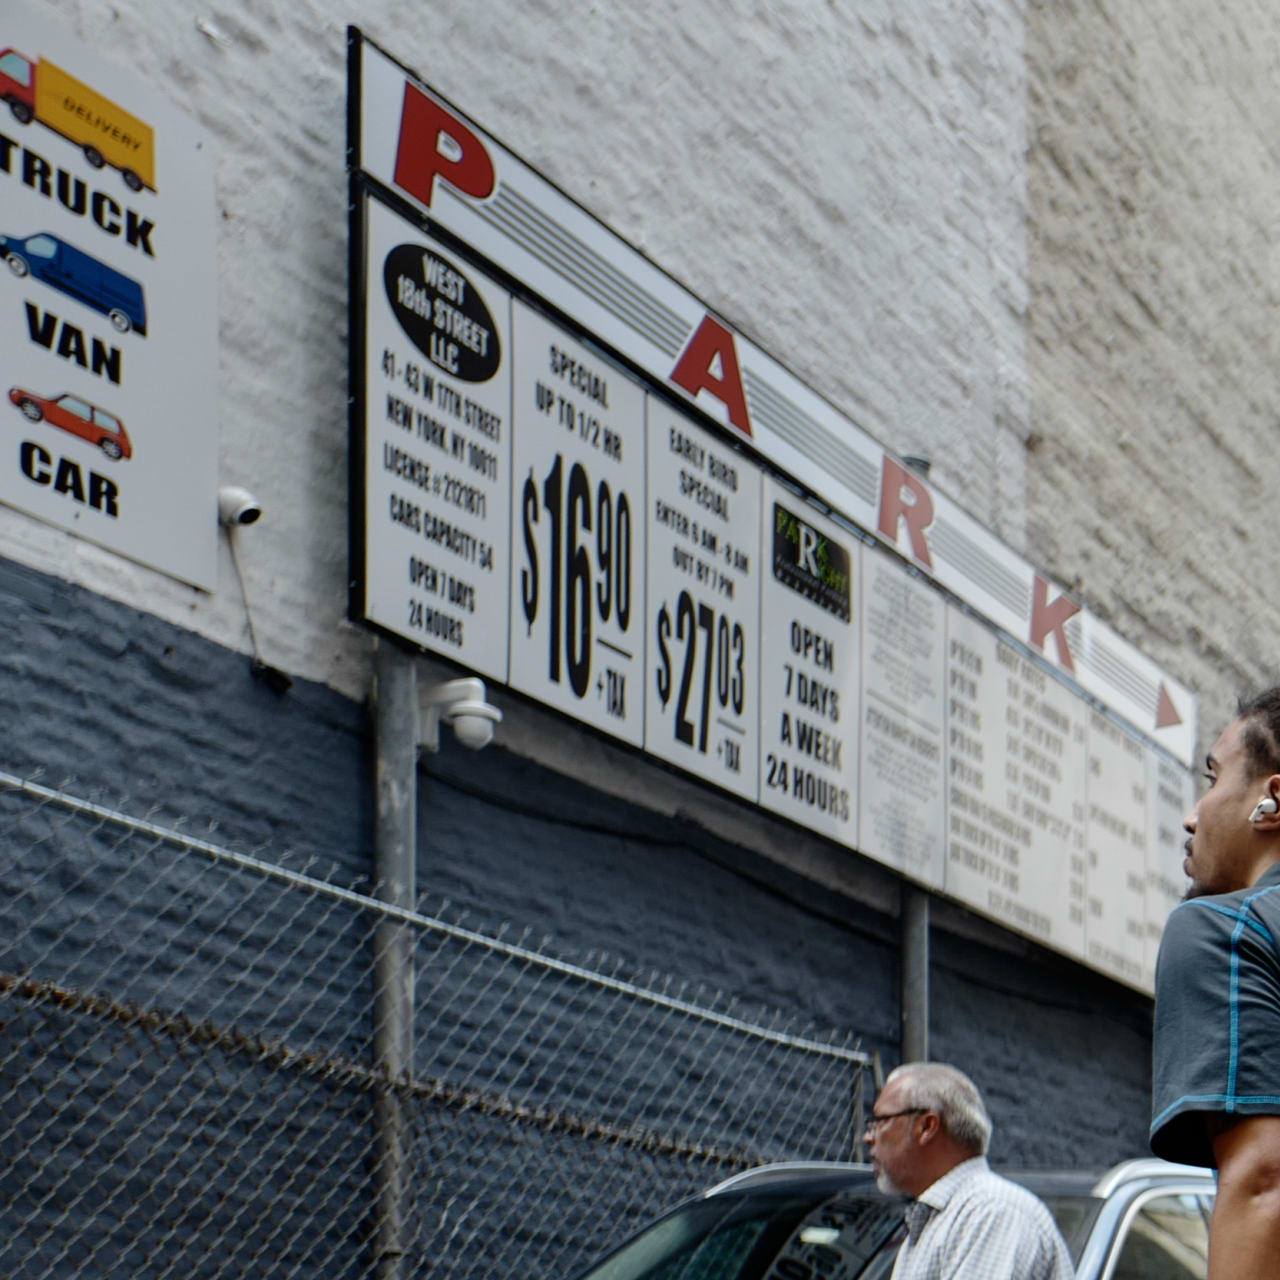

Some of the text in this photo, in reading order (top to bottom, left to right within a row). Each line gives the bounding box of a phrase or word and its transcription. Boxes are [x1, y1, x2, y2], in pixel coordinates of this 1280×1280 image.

[63, 97, 141, 151] DELIVERY
[0, 132, 155, 258] TRUCK
[422, 253, 466, 306] WEST
[24, 299, 121, 386] VAN
[430, 331, 459, 374] LLC
[434, 297, 490, 357] STREET
[382, 348, 395, 379] 41
[422, 372, 434, 403] W
[437, 381, 462, 419] 17TH
[464, 396, 502, 443] STREET
[550, 343, 610, 410] SPECIAL
[387, 392, 413, 432] NEW
[451, 430, 465, 463] NY
[468, 441, 498, 482] 10011
[536, 379, 622, 463] UP TO 1/2 HR
[19, 440, 119, 518] CAR
[384, 440, 430, 492] LICENSE
[669, 425, 738, 493] EARLY BIRD
[679, 468, 730, 522] SPECIAL
[390, 491, 494, 573] CARS CAPACITY 54
[655, 499, 689, 537] ENTER
[701, 528, 717, 555] AM
[734, 547, 749, 576] AM
[410, 554, 476, 614] OPEN 7 DAYS
[673, 544, 694, 576] OUT
[696, 558, 709, 585] BY
[719, 573, 734, 600] PM
[409, 598, 463, 647] 24 HOURS
[791, 619, 834, 673] OPEN
[606, 666, 627, 721] TAX
[784, 662, 840, 724] 7 DAYS
[724, 738, 740, 773] TAX
[780, 710, 792, 747] A
[796, 719, 843, 773] WEEK
[766, 753, 850, 824] 24 HOURS
